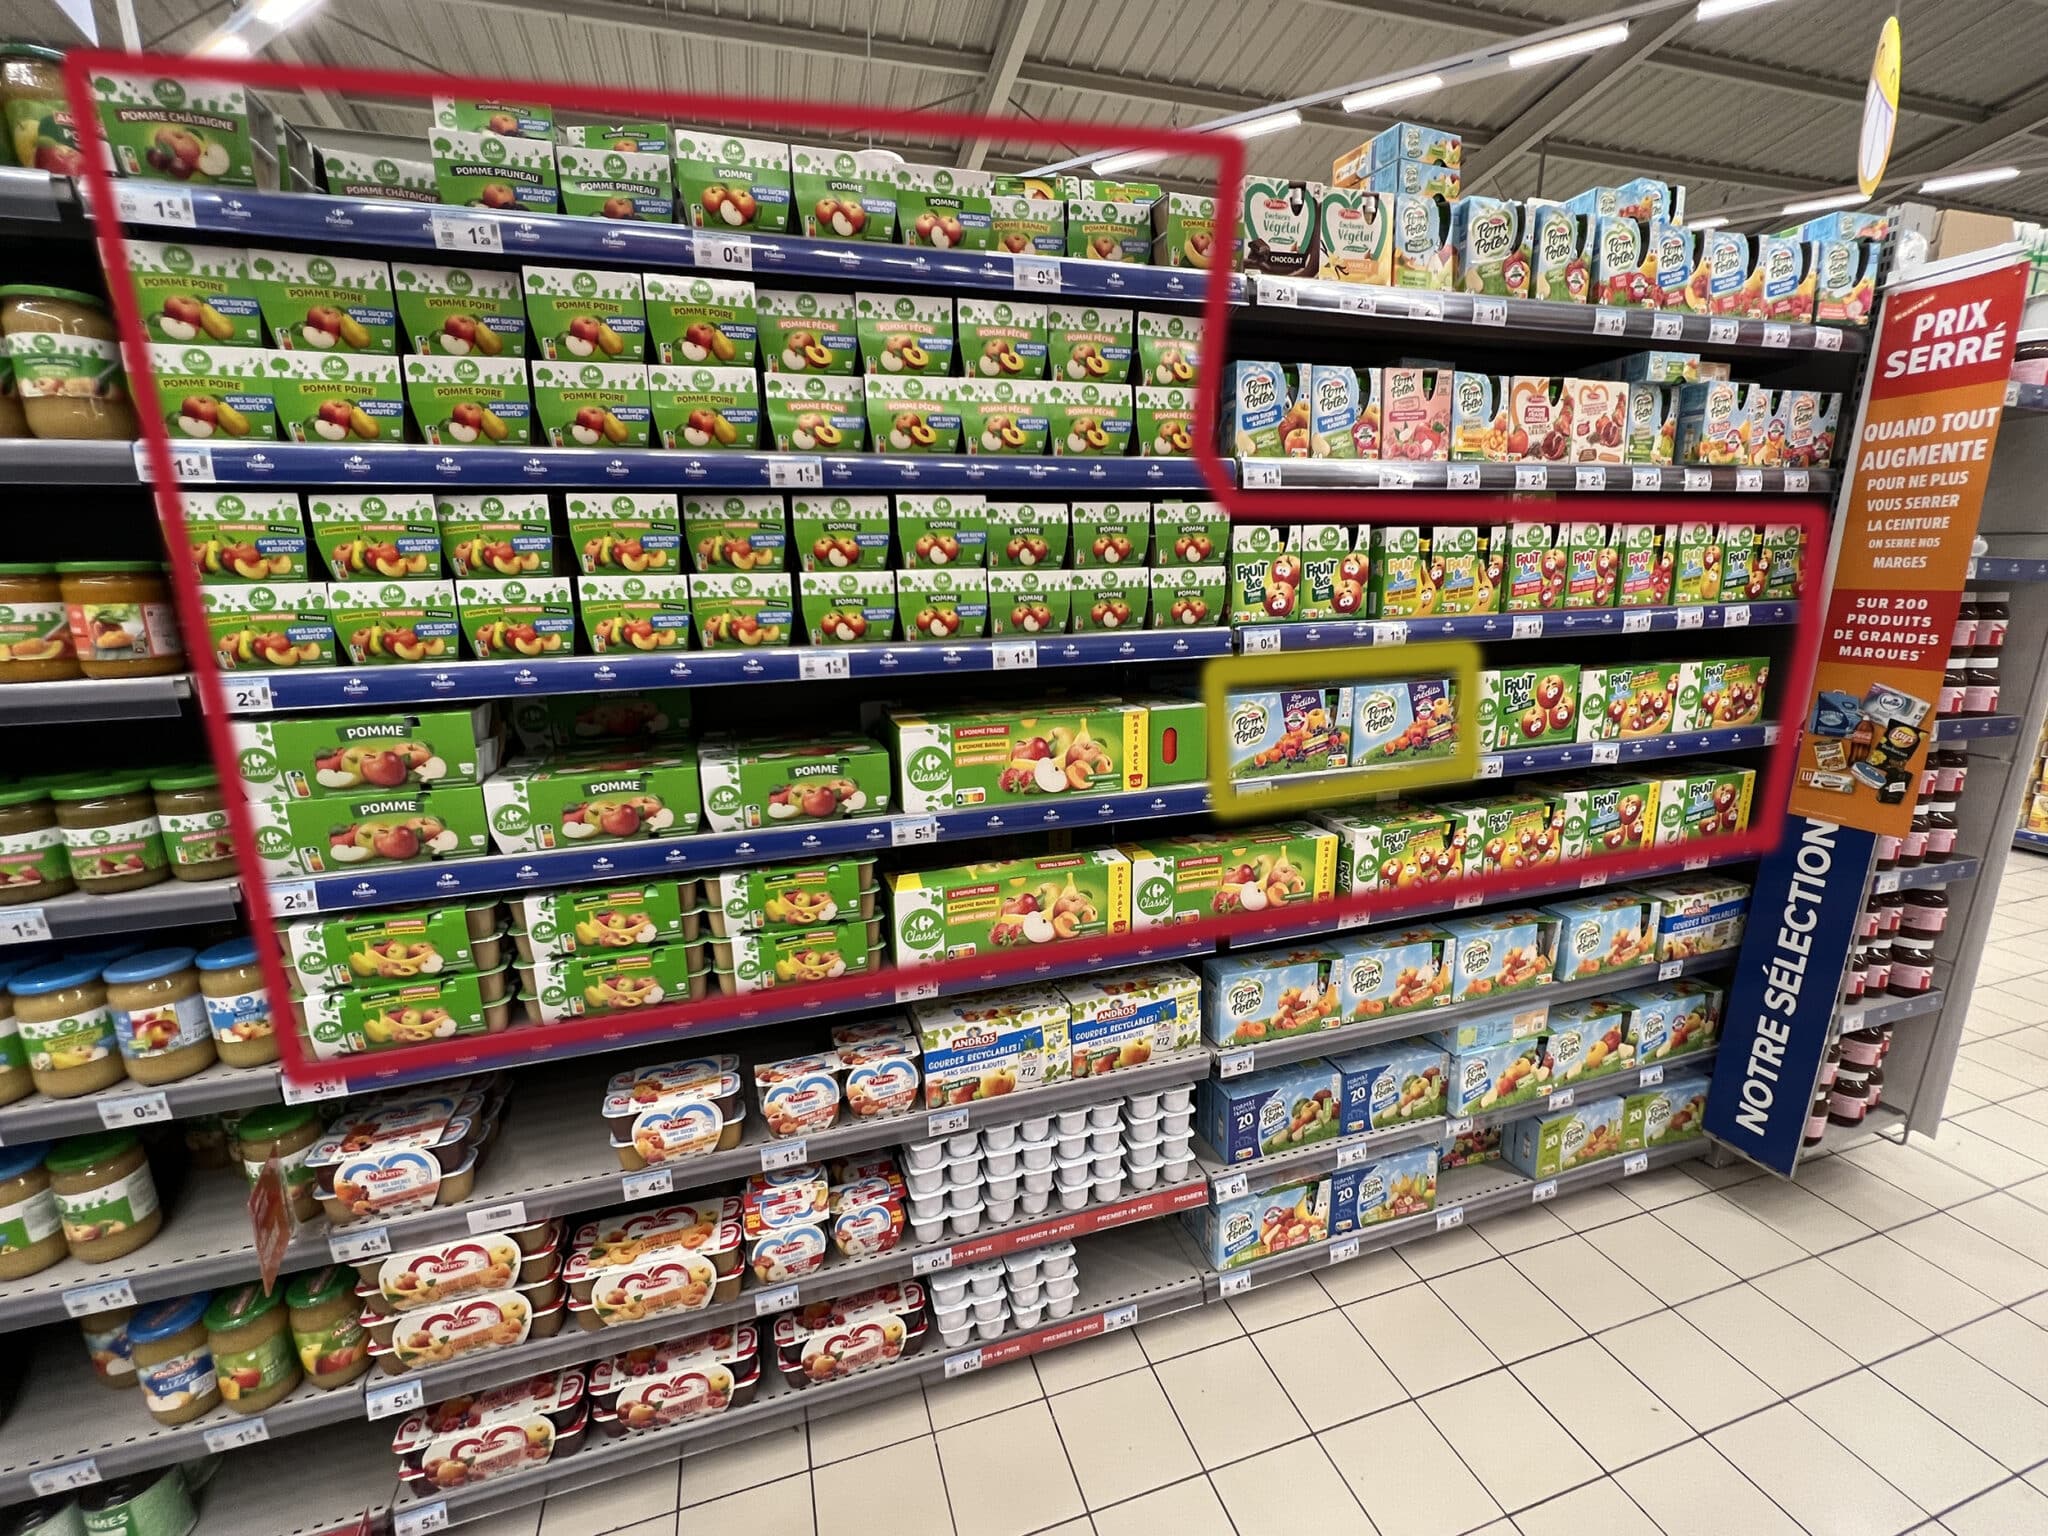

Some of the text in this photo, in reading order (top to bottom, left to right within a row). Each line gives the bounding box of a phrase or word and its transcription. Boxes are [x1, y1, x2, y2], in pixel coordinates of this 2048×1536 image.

[121, 109, 233, 131] POMME CHÂTAIGNE
[456, 166, 539, 183] POMME PRUNEAU
[718, 168, 753, 180] POMME
[581, 182, 656, 196] POMME PRUNEAU
[831, 181, 863, 193] POMME
[346, 186, 438, 203] POMME CHÂTAIGNE
[930, 198, 960, 208] POMME
[1263, 220, 1301, 236] Végétal
[1338, 229, 1374, 244] Végétal
[1270, 255, 1303, 265] CHOCOLAT
[144, 278, 225, 291] POMME POIRE
[290, 288, 363, 302] POMME POIRE
[430, 298, 497, 312] POMME POIRE
[556, 301, 620, 313] POMME POIRE
[674, 307, 733, 320] POMME POIRE
[1912, 299, 1993, 343] PRIX
[1884, 321, 2007, 379] SERRÉ
[163, 379, 241, 391] POMME POIRE
[303, 384, 374, 396] POMME POIRE
[563, 392, 625, 403] POMME POIRE
[676, 395, 735, 405] POMME POIRE
[1864, 407, 2001, 443] QUAND TOUT
[1860, 439, 1989, 472] AUGMENTE
[1867, 471, 1969, 491] POUR NE PLUS
[1867, 494, 1960, 512] VOUS SERRER
[827, 522, 857, 532] POMME
[929, 520, 958, 530] POMME
[1100, 525, 1126, 534] POMME
[1181, 525, 1206, 534] POMME
[1867, 516, 1951, 532] LA CEINTURE
[1013, 527, 1040, 536] POMME
[1868, 537, 1941, 549] ON SERRE NOS
[1873, 556, 1928, 569] MARGES
[835, 598, 865, 607] POMME
[930, 595, 958, 604] POMME
[1018, 595, 1044, 603] POMME
[1856, 598, 1929, 610] SUR 200
[1846, 613, 1932, 627] PRODUITS
[1833, 629, 1940, 646] DE GRANDES
[1504, 674, 1535, 696] FRUIT
[1413, 686, 1441, 702] inédits
[1286, 696, 1317, 711] inédits
[346, 726, 404, 739] POMME
[795, 764, 839, 777] POMME
[911, 767, 949, 783] Classic
[591, 780, 641, 795] POMME
[360, 801, 416, 814] POMME
[1140, 896, 1172, 908] Classic
[1763, 817, 1840, 1018] SÉLECTION
[905, 928, 941, 942] Classic
[1098, 1007, 1135, 1021] ANDROS
[1075, 1027, 1107, 1041] GOURDES
[953, 1034, 996, 1050] ANDROS
[1088, 1039, 1101, 1048] SANS
[928, 1056, 965, 1070] GOURDES
[943, 1068, 959, 1078] SANS
[959, 1064, 980, 1075] SUCRES
[1736, 1016, 1792, 1136] NOTRE
[1350, 1087, 1366, 1103] 20
[1237, 1113, 1254, 1130] 20
[1629, 1109, 1642, 1122] 20
[1545, 1136, 1558, 1148] 20
[1174, 1191, 1203, 1203] PREMIER
[1337, 1187, 1354, 1203] 20
[1097, 1204, 1153, 1222] PREMIER PRIX
[1016, 1223, 1075, 1243] PREMIER PRIX
[975, 1244, 992, 1254] PRIX
[1043, 1322, 1099, 1343] PREMIER PRIX
